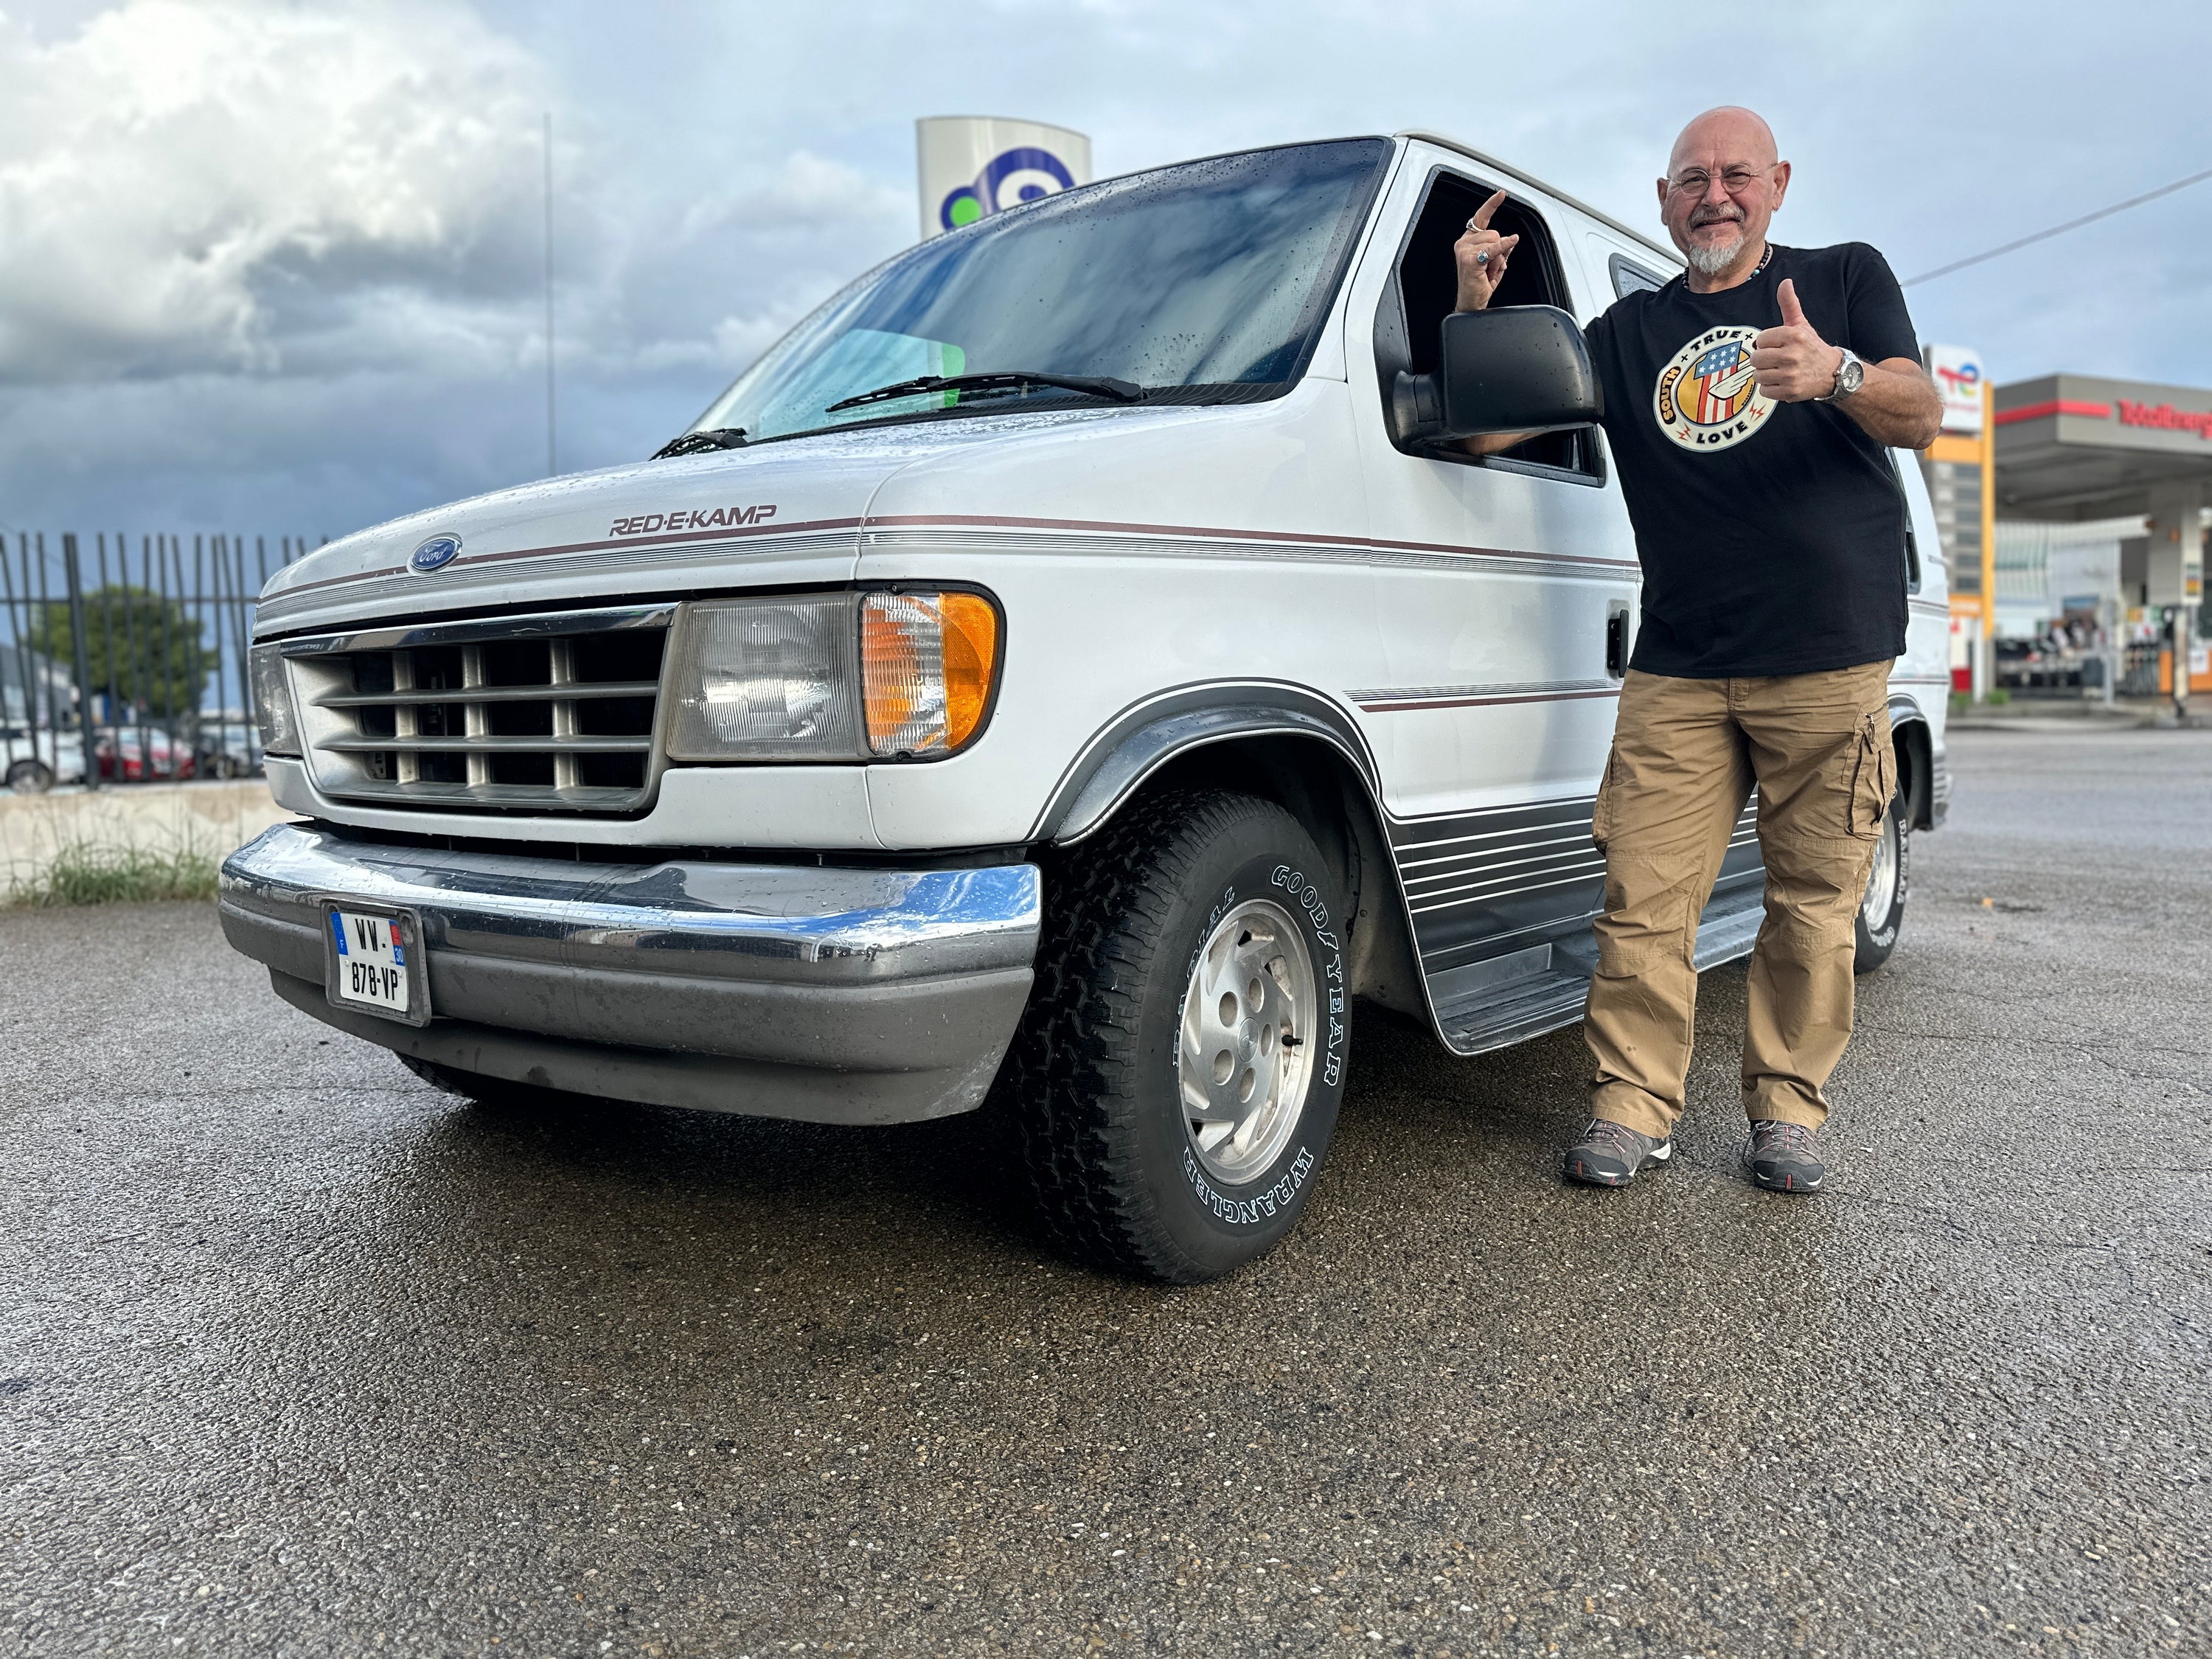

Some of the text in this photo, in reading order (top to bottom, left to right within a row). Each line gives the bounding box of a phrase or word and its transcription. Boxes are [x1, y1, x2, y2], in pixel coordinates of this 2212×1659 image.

[1691, 330, 1742, 353] TRUE
[1661, 368, 1680, 420] SOUTH
[1696, 420, 1748, 445] LOVE
[419, 543, 448, 563] Ford
[340, 939, 344, 949] F
[394, 947, 404, 963] 30
[352, 961, 398, 1001] 878-VP
[1183, 1146, 1315, 1224] WRANGLER
